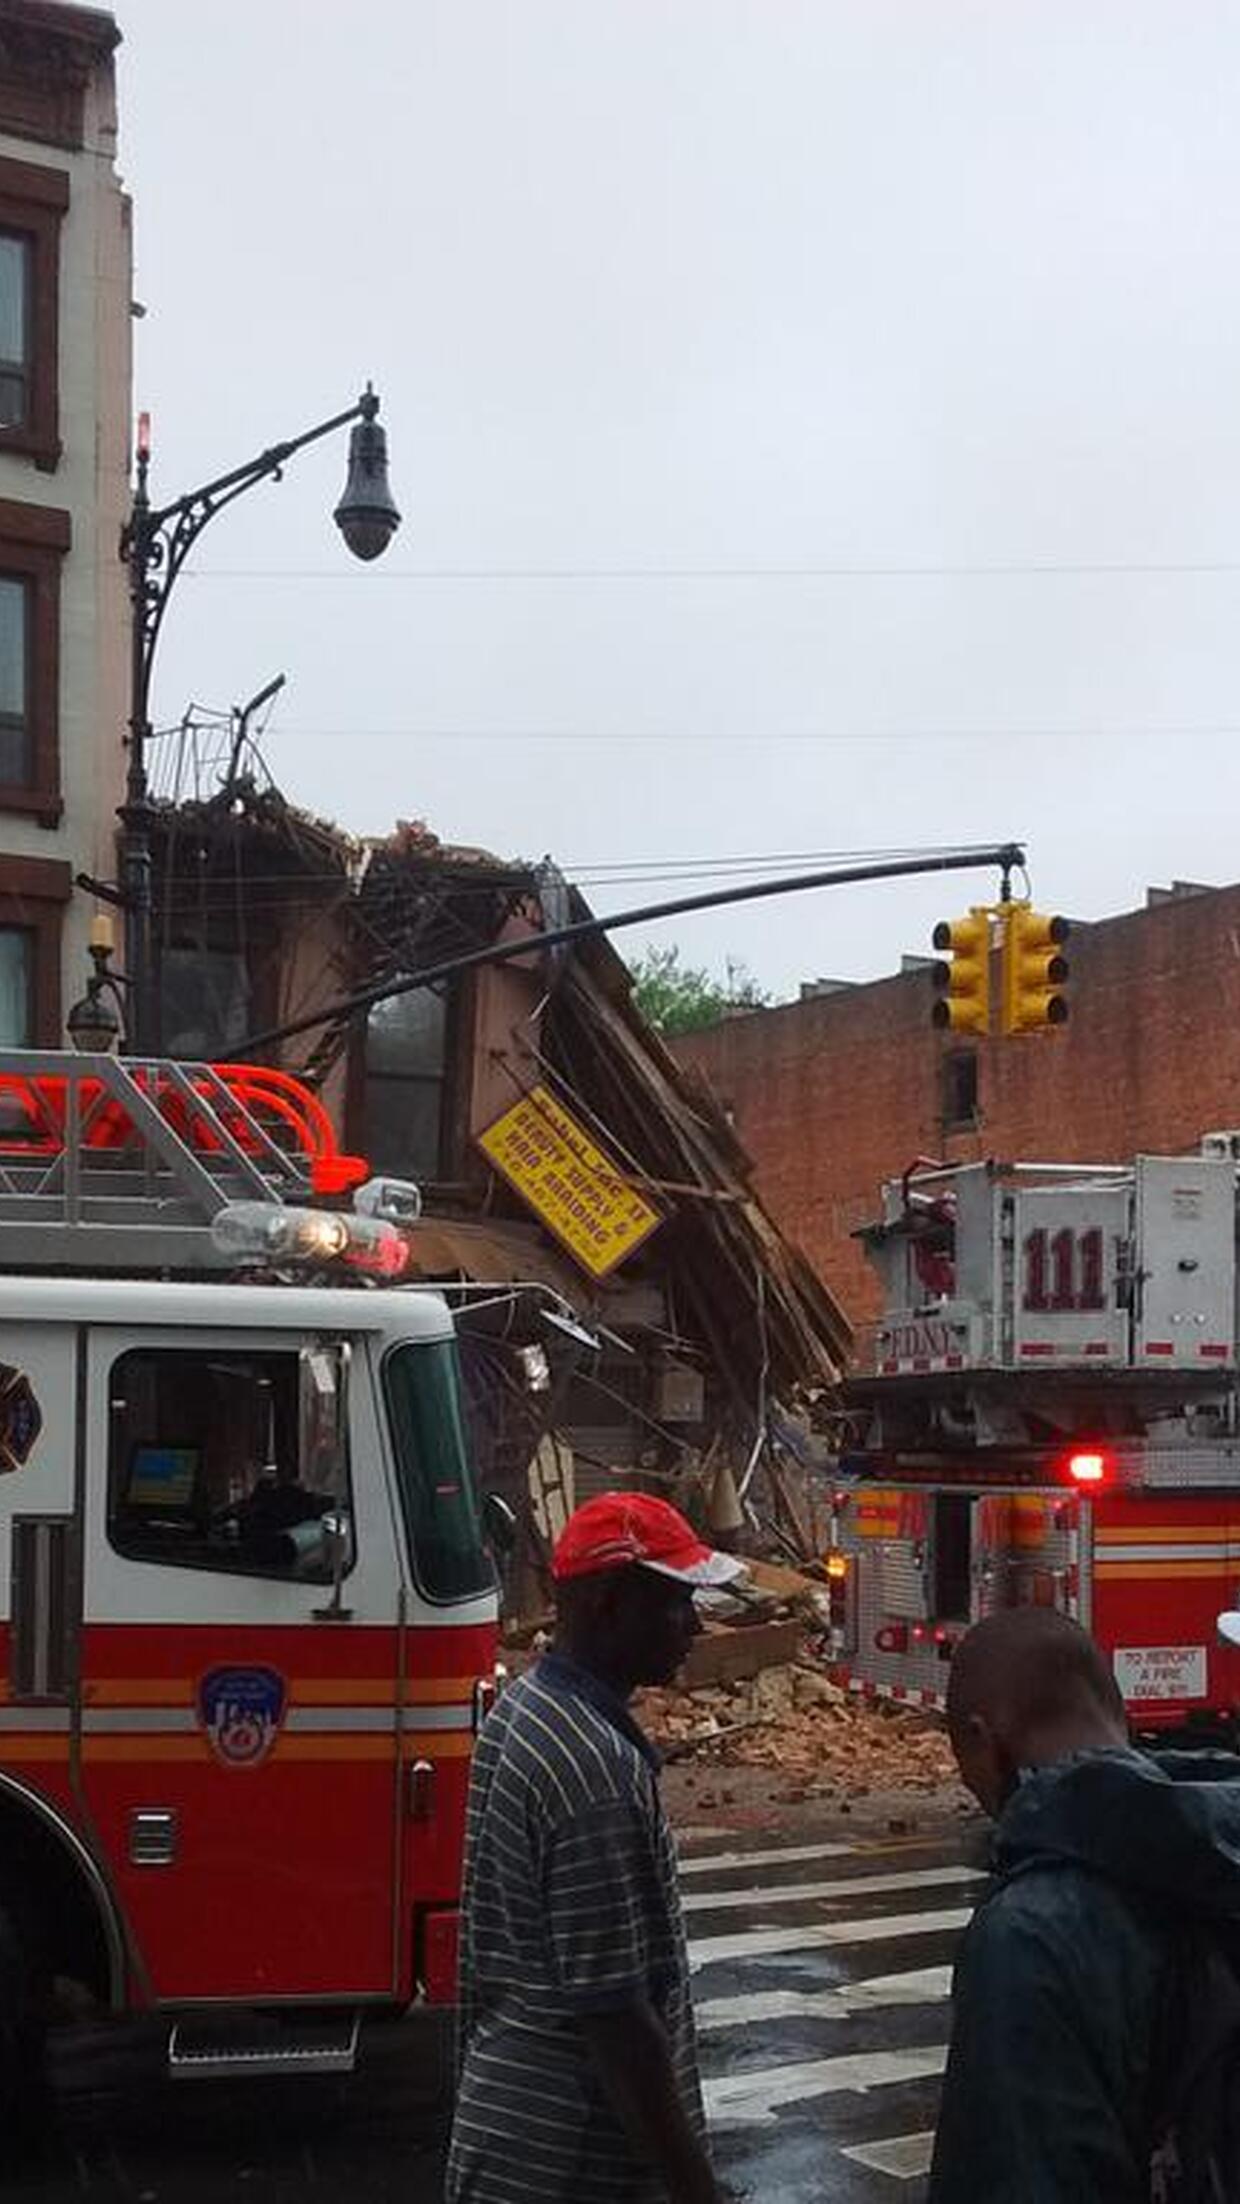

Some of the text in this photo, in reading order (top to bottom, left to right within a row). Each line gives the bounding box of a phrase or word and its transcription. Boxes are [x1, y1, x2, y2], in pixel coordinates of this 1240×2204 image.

[505, 1130, 541, 1169] HAIR
[541, 1170, 611, 1246] BRAIDING
[515, 1112, 564, 1165] BEAUTY
[564, 1166, 615, 1219] SUPPLY
[1022, 1227, 1106, 1312] 111
[1125, 1652, 1142, 1665] TO
